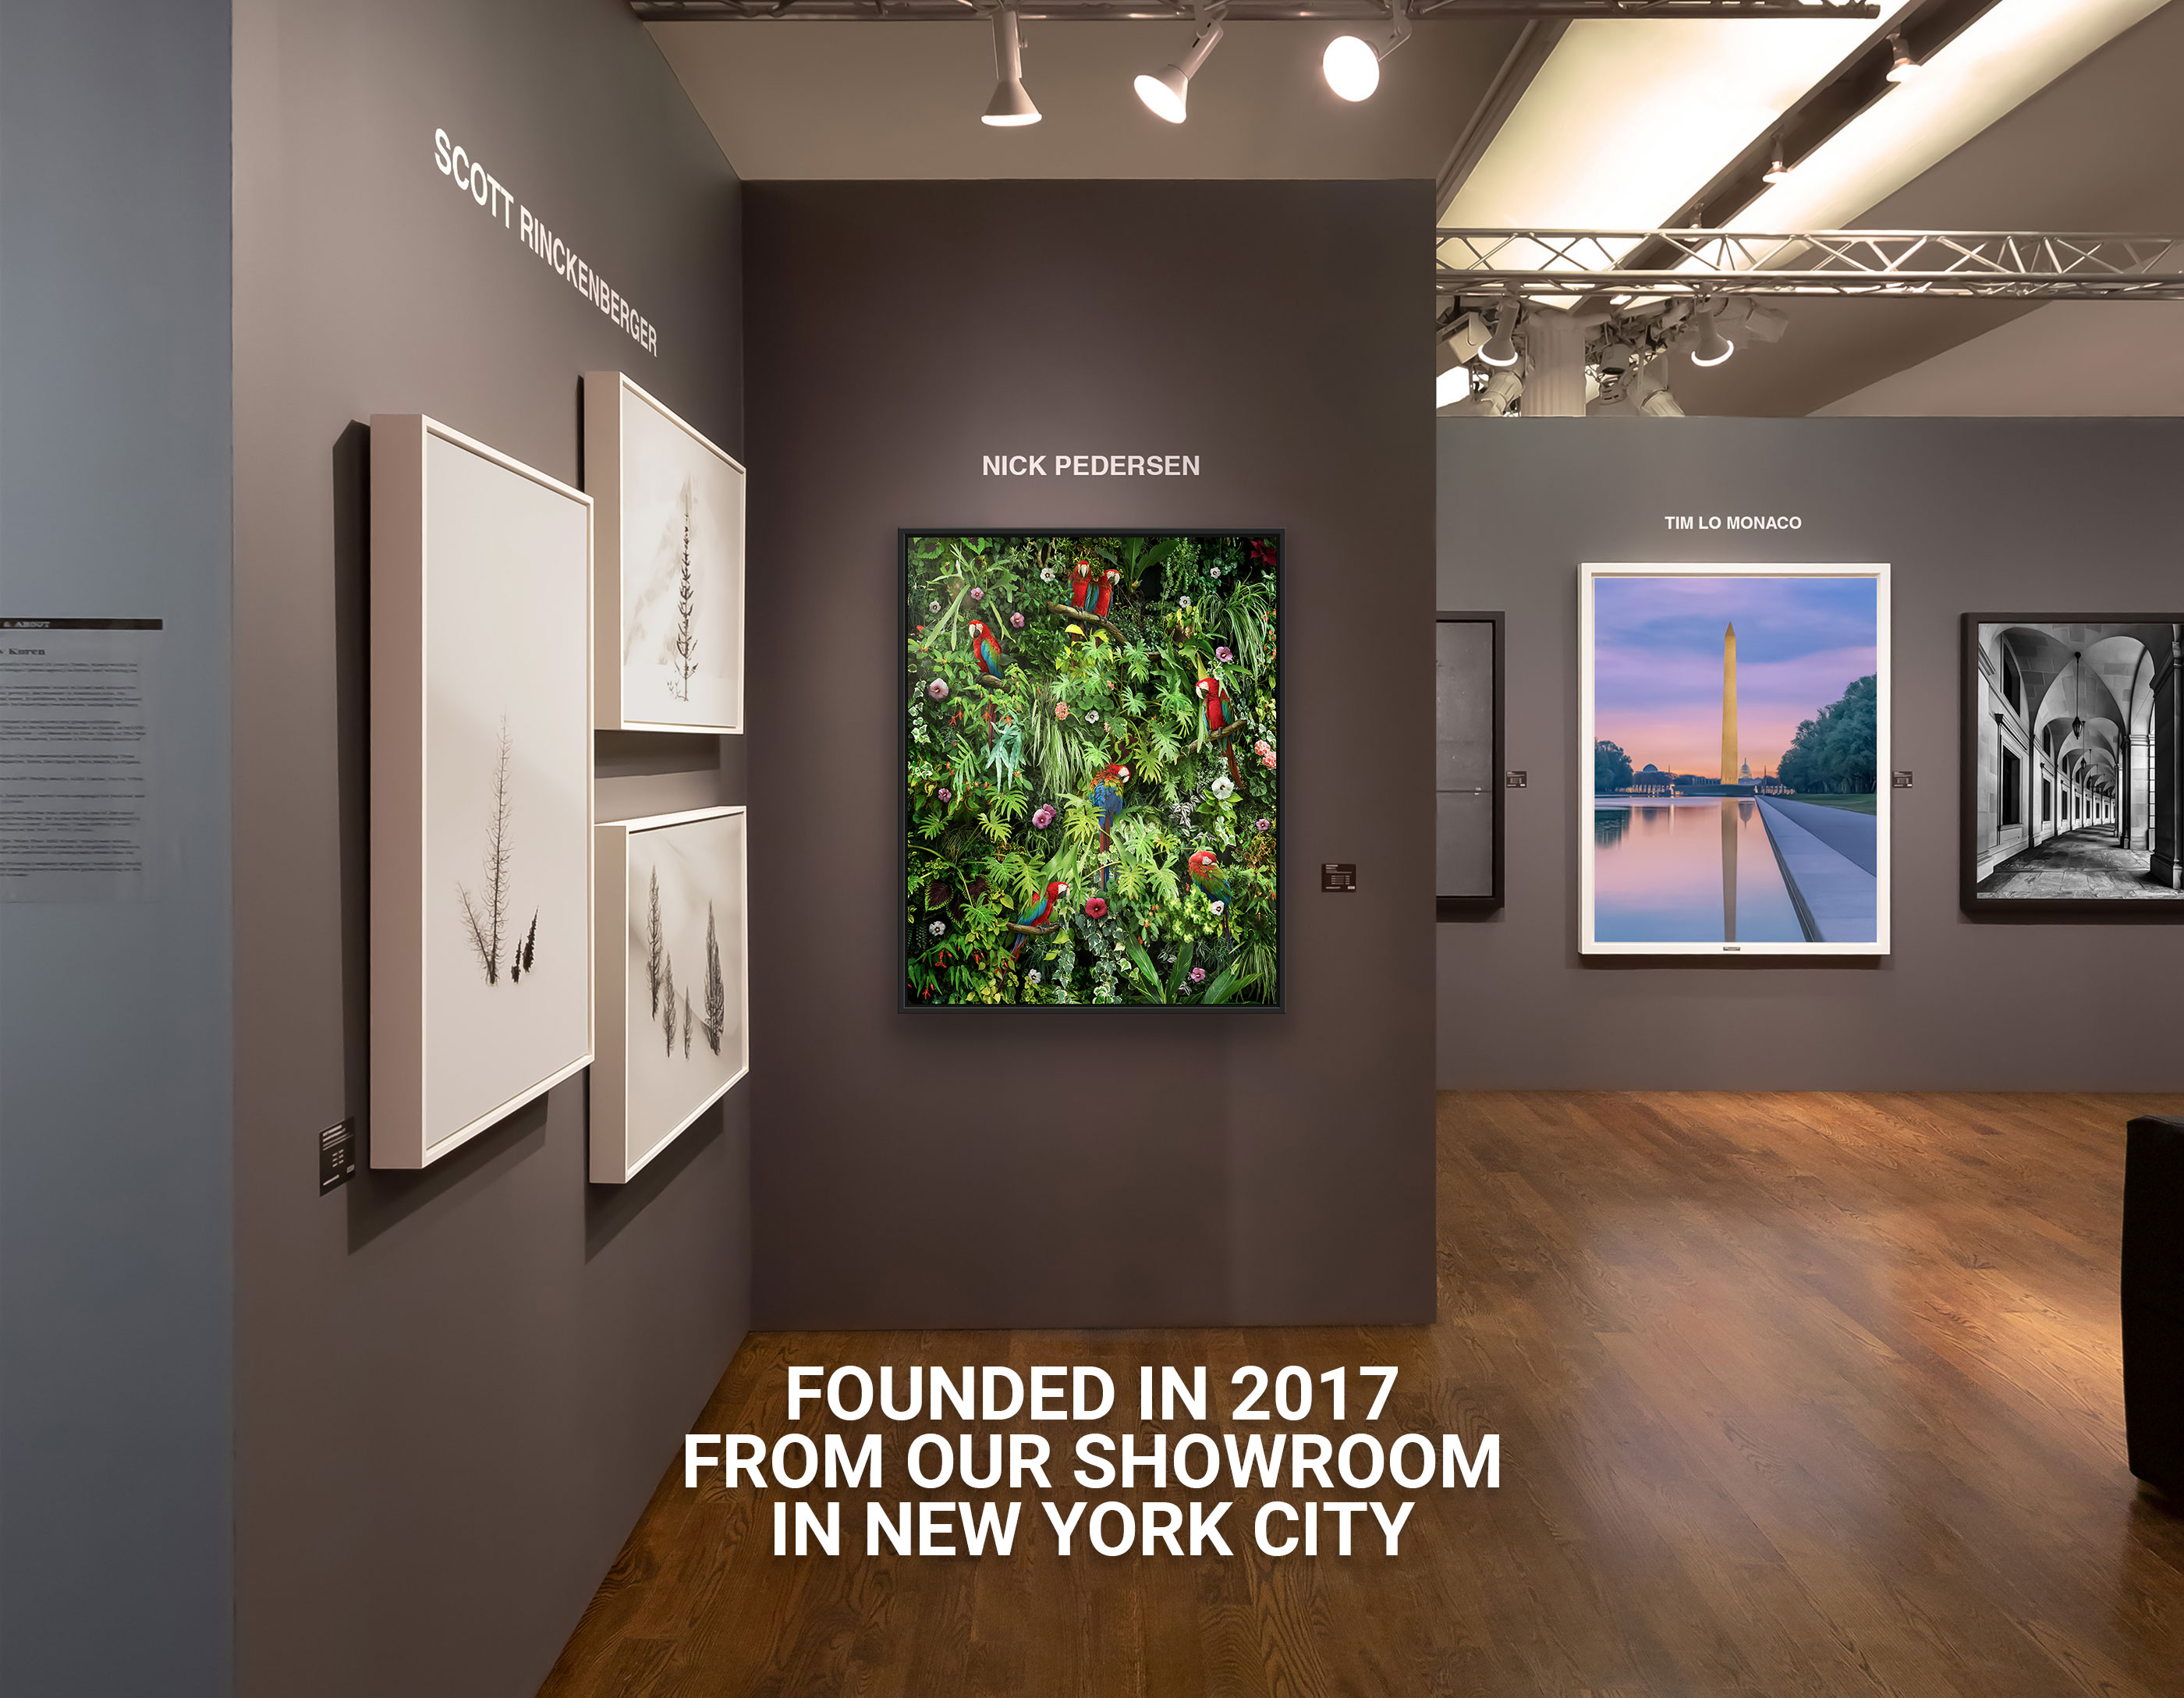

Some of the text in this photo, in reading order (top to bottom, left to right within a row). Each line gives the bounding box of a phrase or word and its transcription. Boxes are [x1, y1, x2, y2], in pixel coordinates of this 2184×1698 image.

[434, 128, 658, 357] SCOTT RINCKENBERGER
[983, 455, 1200, 476] NICK PEDERSEN
[1664, 516, 1802, 530] TIM LO MONACO
